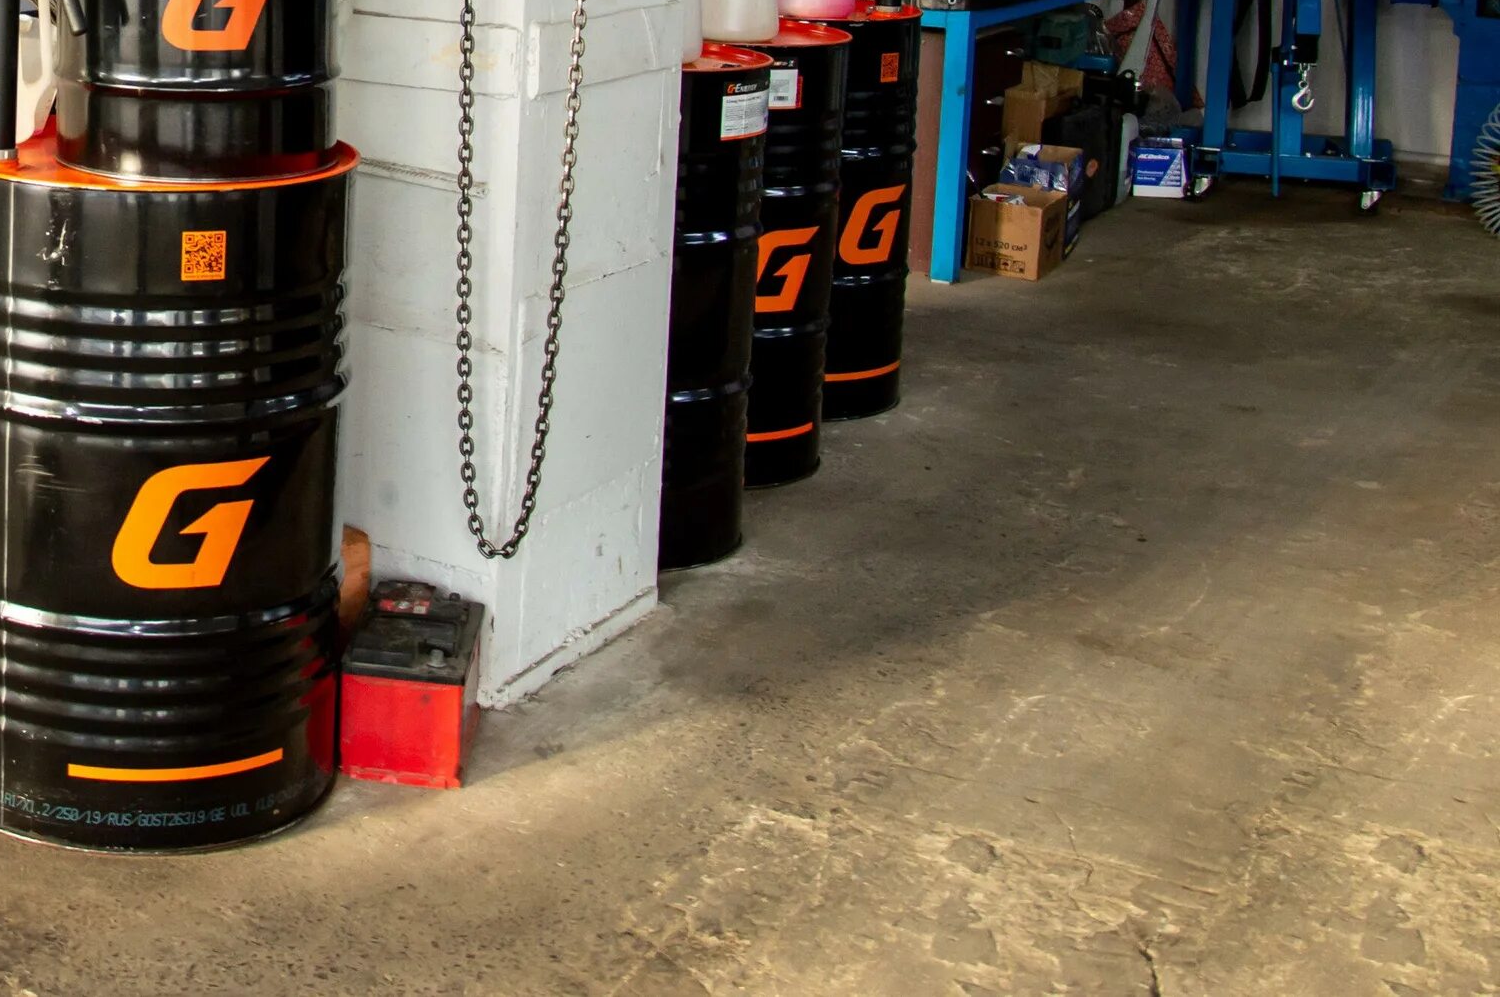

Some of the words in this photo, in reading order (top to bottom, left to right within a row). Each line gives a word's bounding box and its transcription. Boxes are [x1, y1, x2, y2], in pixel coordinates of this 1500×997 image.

[839, 184, 906, 265] G
[755, 226, 820, 313] G
[111, 456, 272, 589] G
